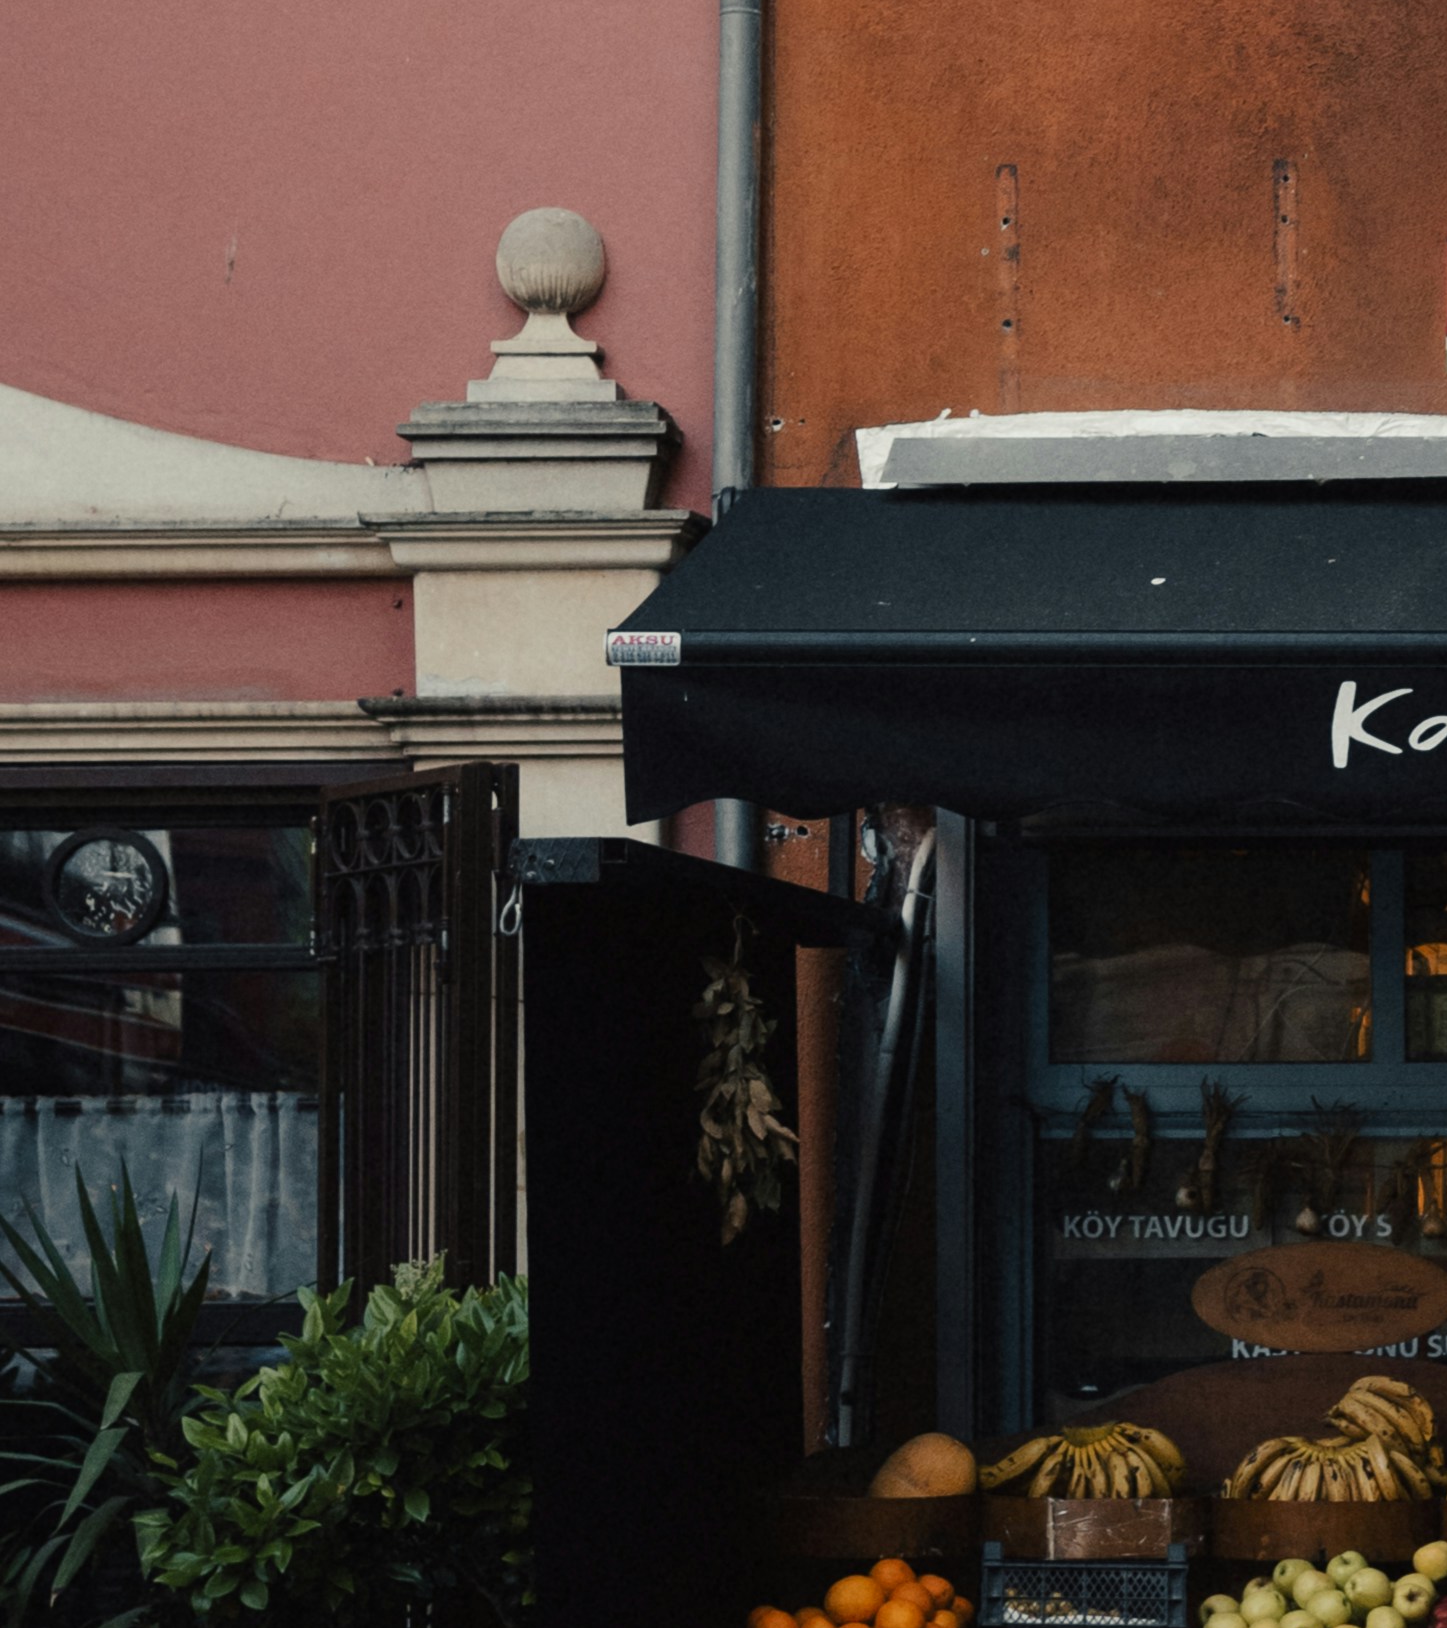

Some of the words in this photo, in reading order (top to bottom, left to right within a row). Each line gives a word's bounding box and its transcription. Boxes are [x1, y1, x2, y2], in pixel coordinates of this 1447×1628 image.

[611, 635, 675, 646] AKSU
[1064, 1209, 1124, 1240] KÖY
[1319, 1209, 1369, 1238] ÖY
